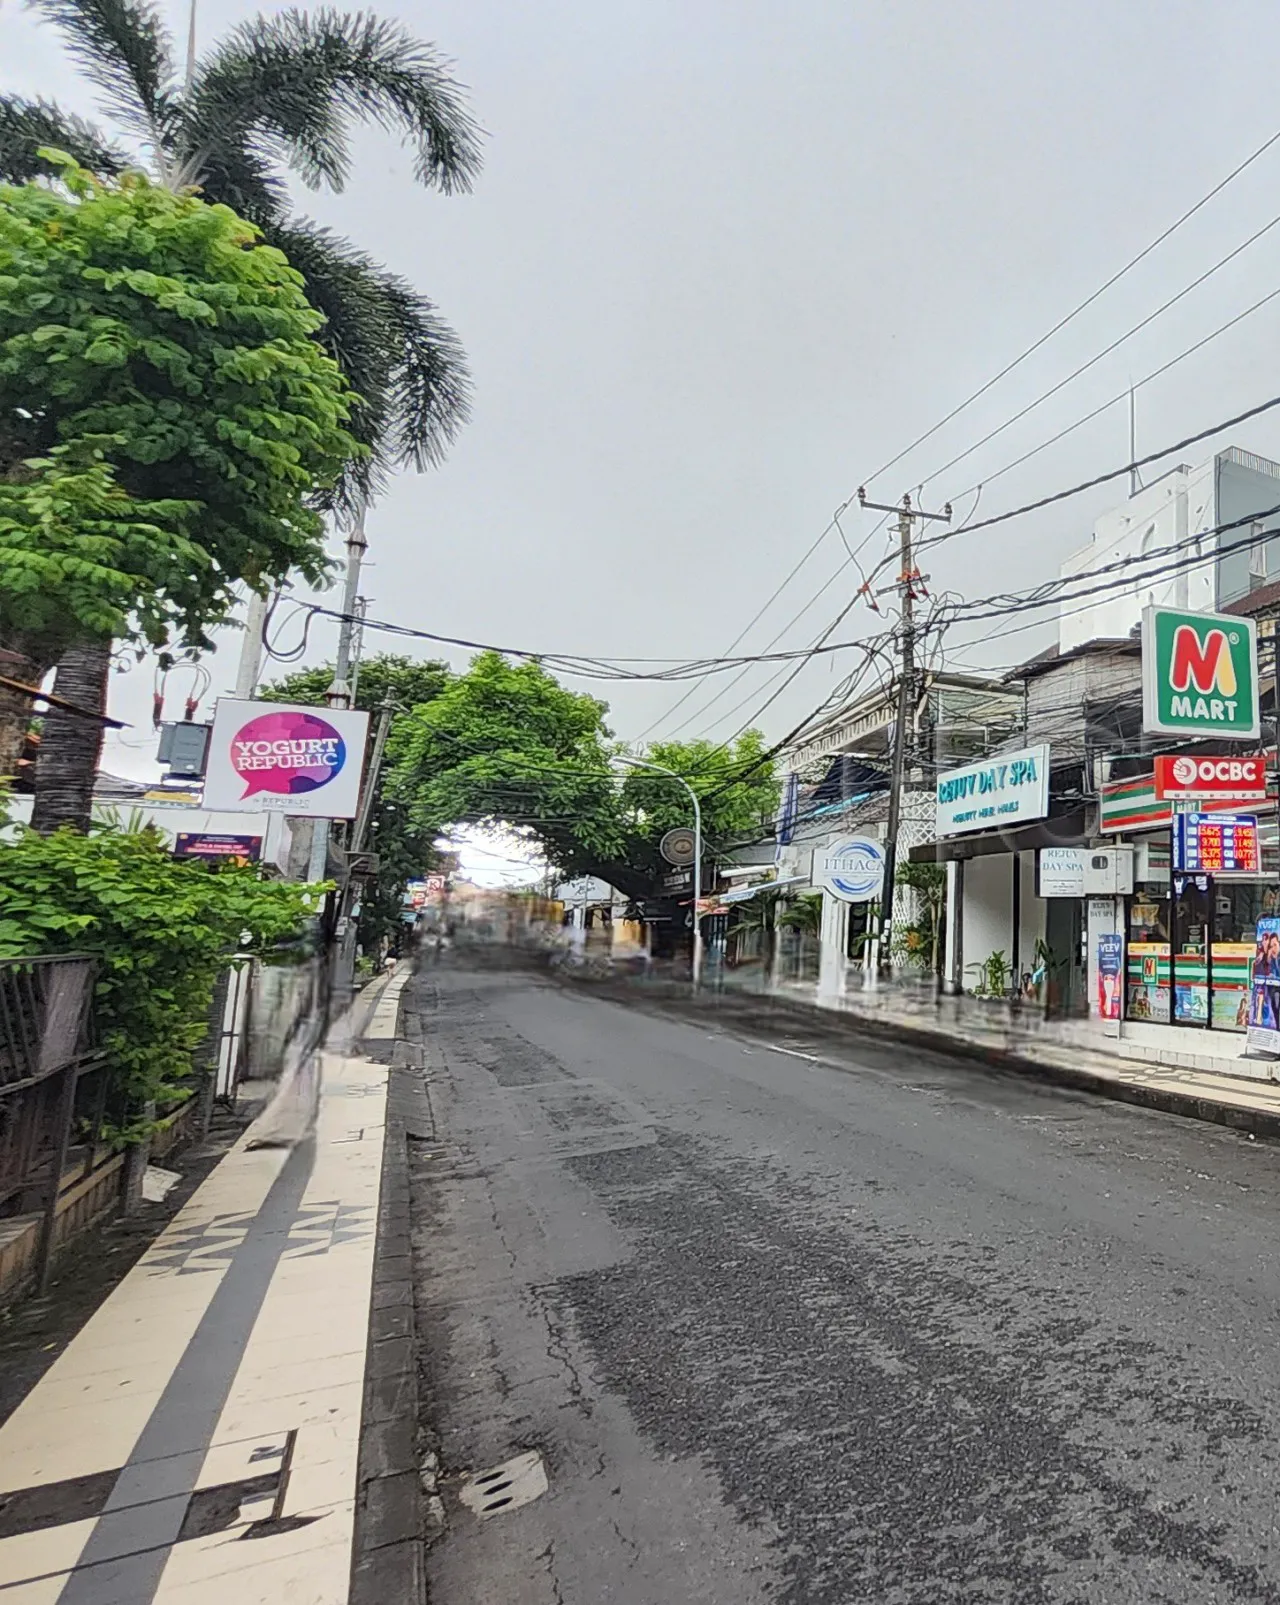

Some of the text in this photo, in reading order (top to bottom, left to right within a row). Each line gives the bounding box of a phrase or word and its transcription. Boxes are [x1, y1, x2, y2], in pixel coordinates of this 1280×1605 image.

[1171, 696, 1238, 721] MART
[235, 738, 339, 757] YOGURT
[237, 753, 338, 771] REPUBLIC
[1198, 761, 1257, 781] OCBC
[978, 764, 1008, 794] DAY
[1010, 757, 1038, 786] SPA
[824, 858, 885, 870] ITHACA
[1042, 863, 1084, 871] DAY SPA
[1100, 943, 1120, 952] VEEV
